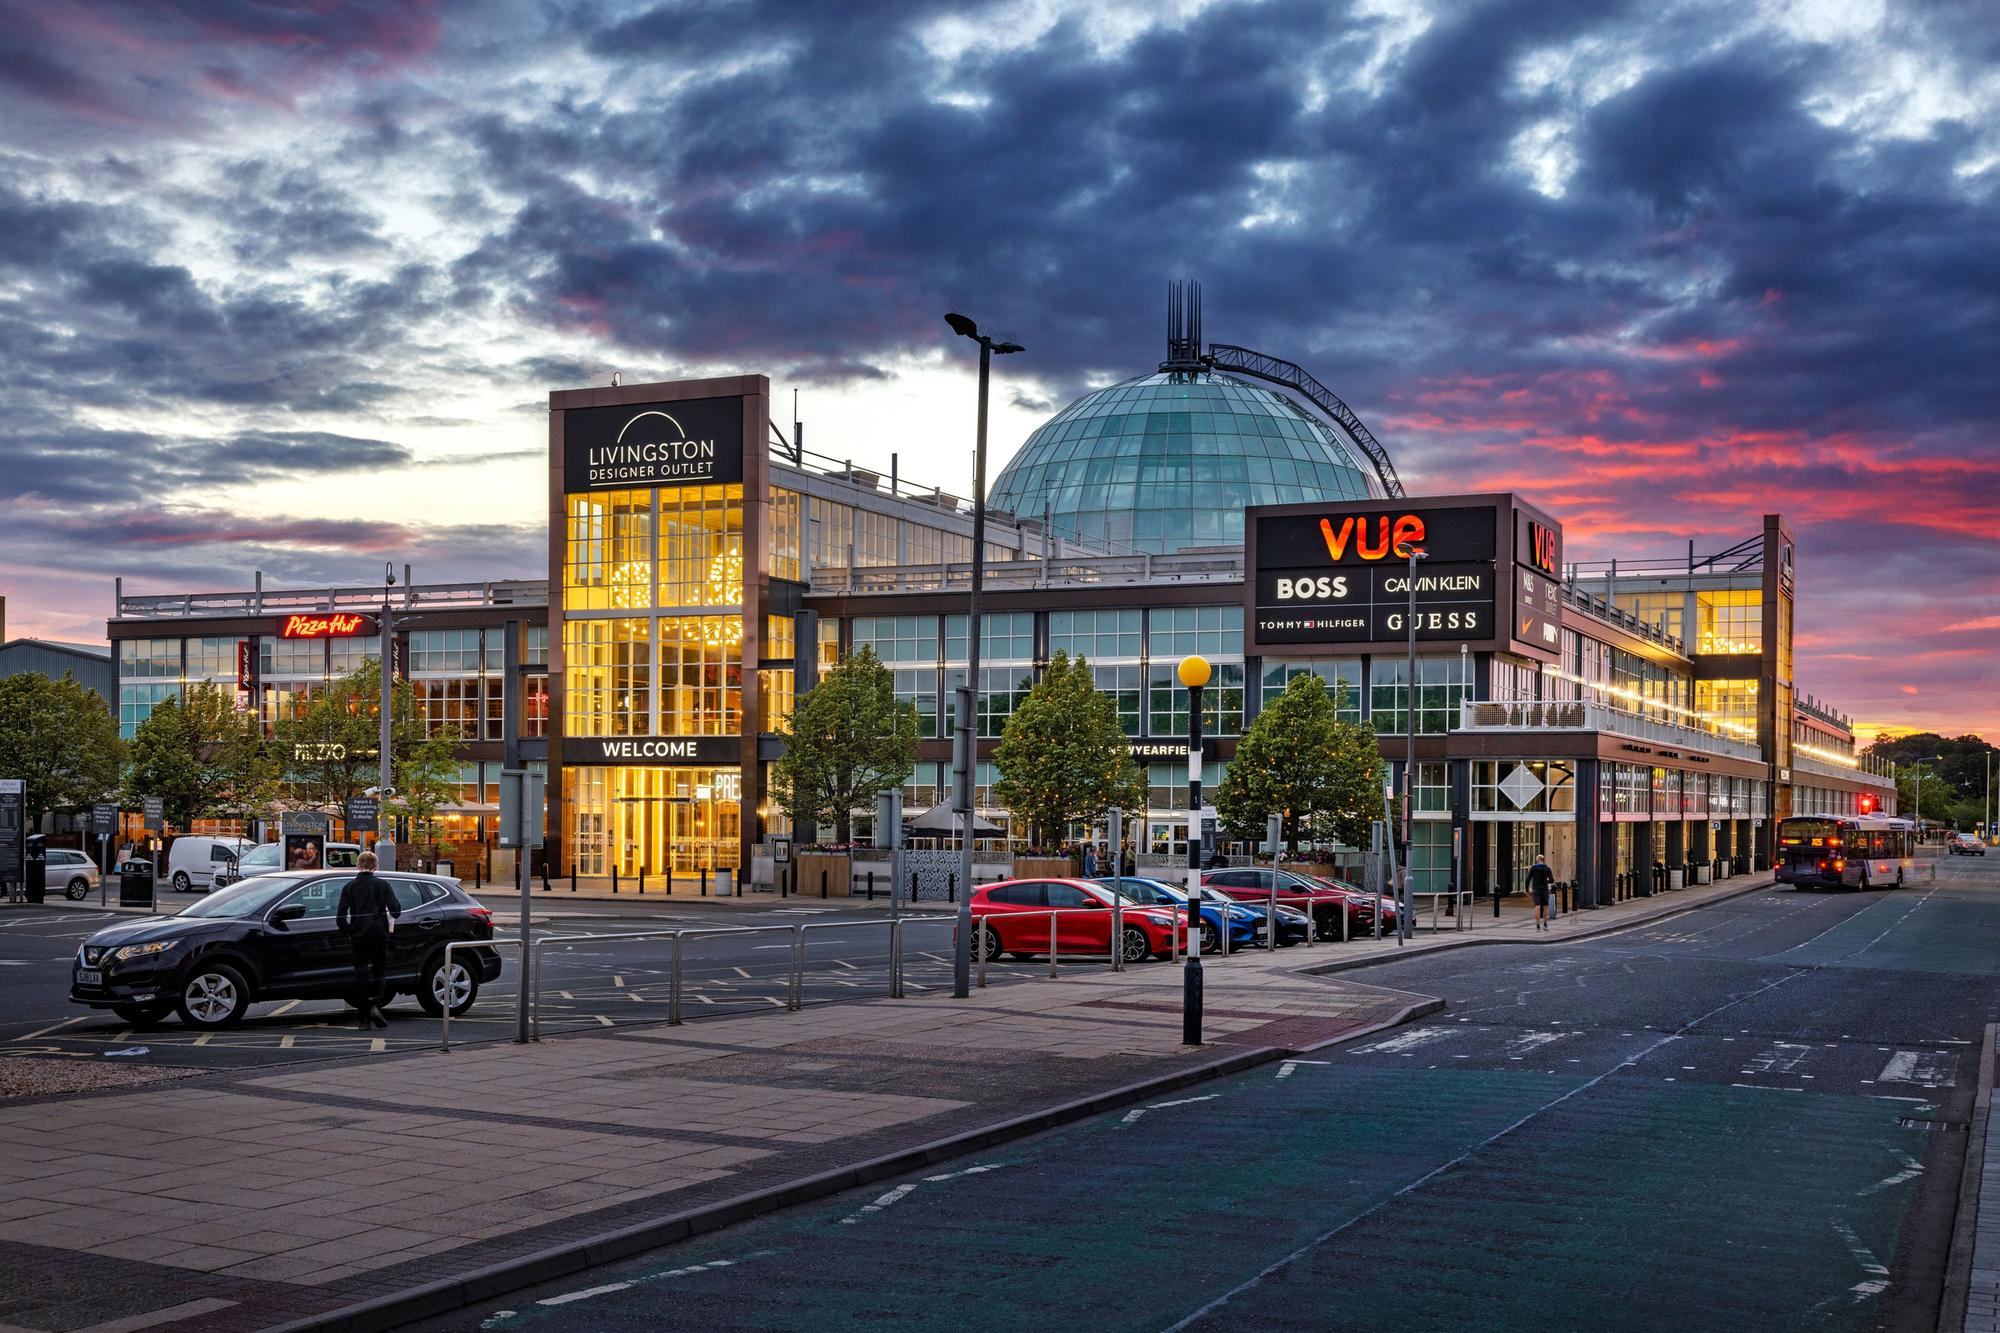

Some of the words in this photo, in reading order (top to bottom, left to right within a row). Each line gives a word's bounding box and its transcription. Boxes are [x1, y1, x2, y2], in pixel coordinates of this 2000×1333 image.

[589, 439, 714, 466] LIVINGSTON
[589, 465, 655, 480] DESIGNER
[660, 461, 713, 476] OUTLET
[1277, 576, 1348, 599] BOSS
[1385, 577, 1437, 592] CALVIN
[1439, 575, 1480, 591] KLEIN
[1523, 571, 1534, 593] M&S
[284, 614, 328, 637] Pizza
[329, 614, 363, 634] Hut
[1259, 620, 1302, 630] TOMMY
[1317, 618, 1366, 628] HILFIGER
[242, 664, 250, 688] Pizza
[392, 660, 400, 684] Pizza
[602, 741, 697, 758] WELCOME
[715, 774, 742, 800] PRE
[1714, 822, 1720, 830] D
[1811, 838, 1823, 846] X25
